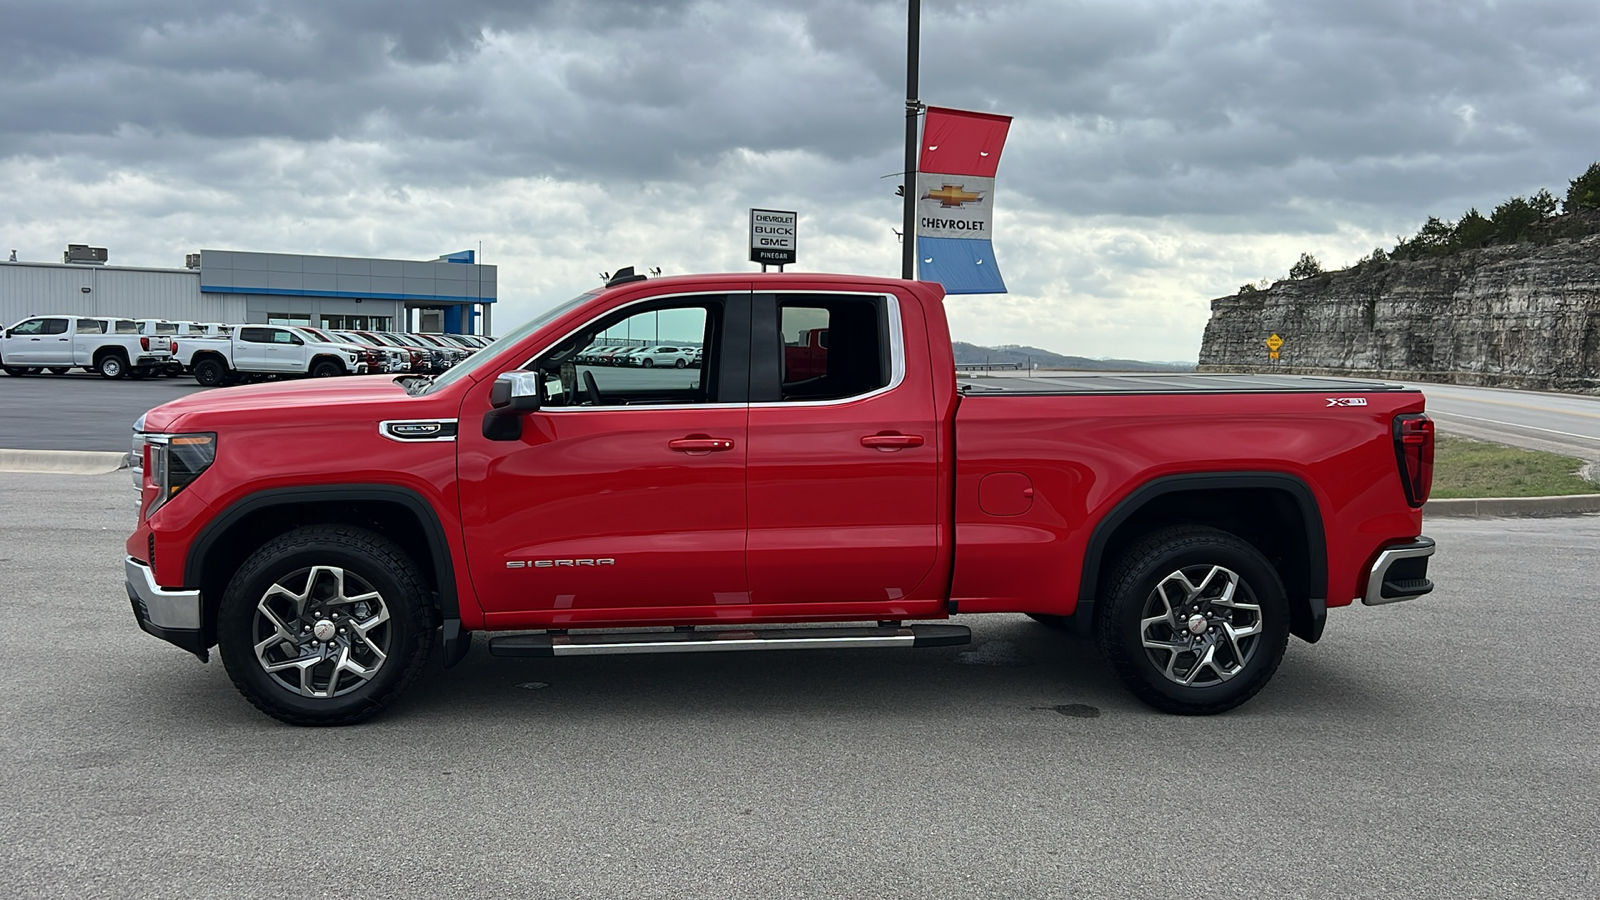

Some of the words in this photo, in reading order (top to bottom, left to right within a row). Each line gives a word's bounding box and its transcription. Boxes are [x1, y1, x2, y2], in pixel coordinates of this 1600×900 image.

[756, 214, 793, 223] CHEVROLET
[755, 226, 793, 235] BUICK
[760, 238, 788, 246] GMC
[506, 558, 615, 568] SIERRA
